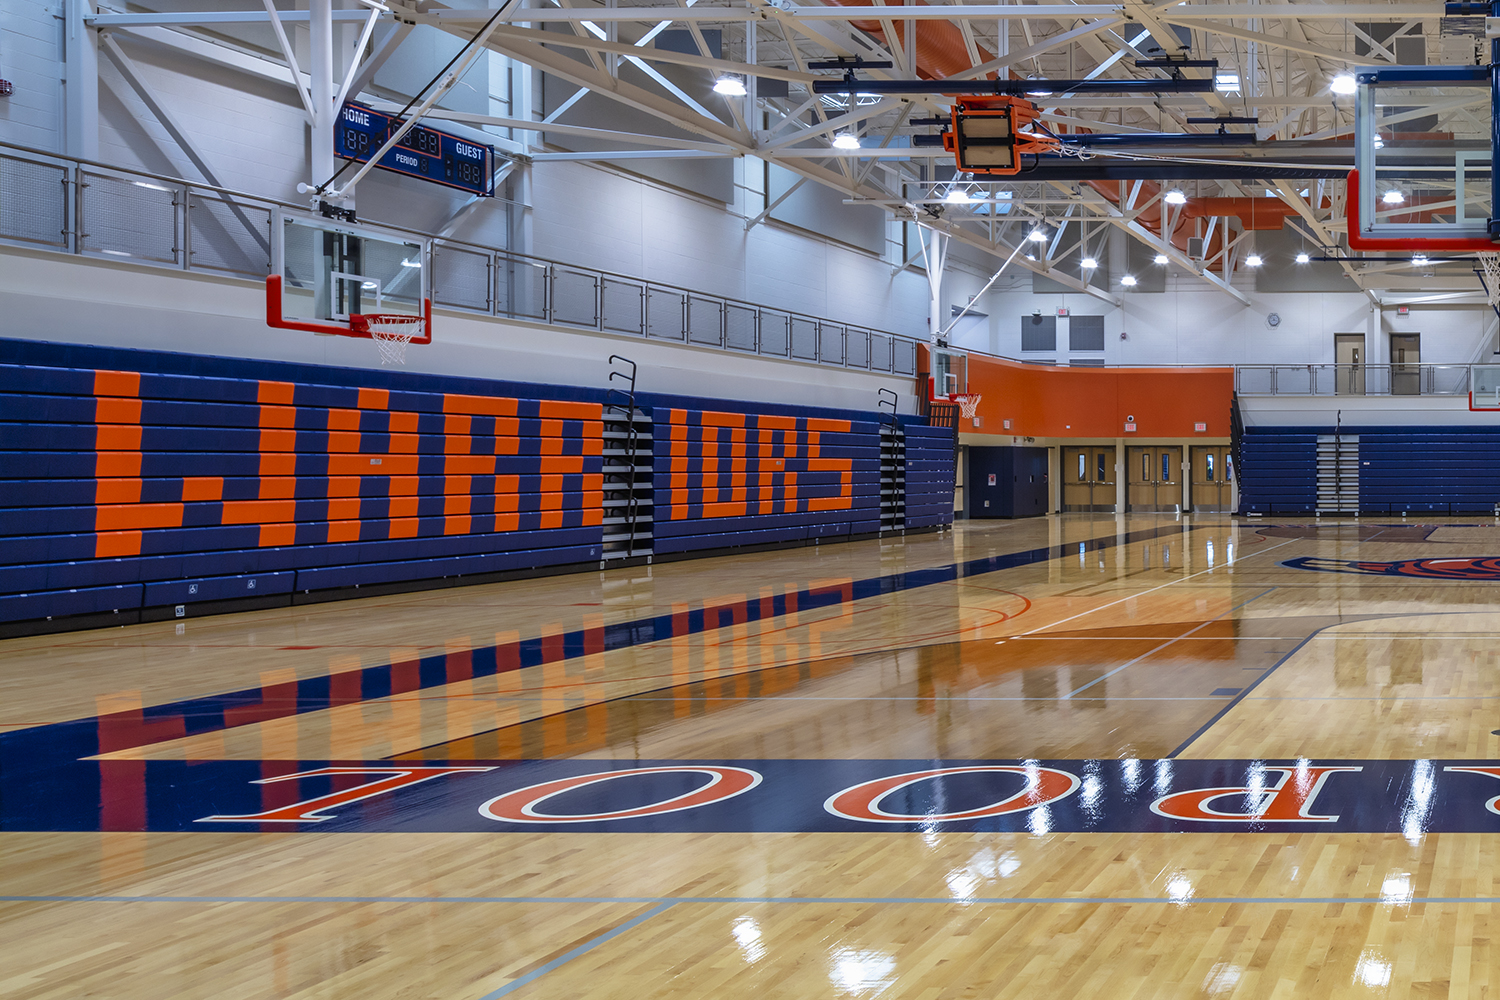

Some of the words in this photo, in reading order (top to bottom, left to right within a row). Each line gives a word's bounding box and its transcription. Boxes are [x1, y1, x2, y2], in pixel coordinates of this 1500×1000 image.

[342, 108, 370, 127] HOME
[395, 153, 418, 167] PERIOD
[456, 142, 482, 160] GUEST
